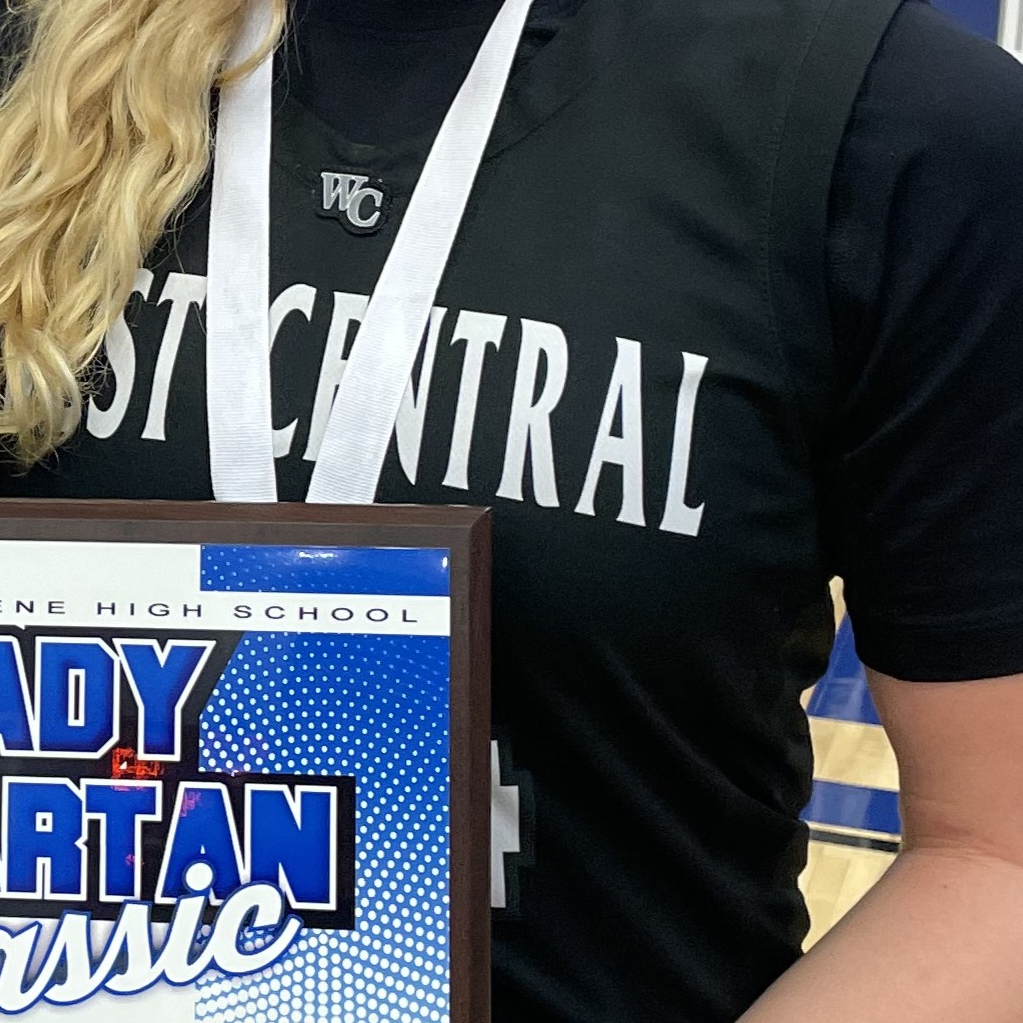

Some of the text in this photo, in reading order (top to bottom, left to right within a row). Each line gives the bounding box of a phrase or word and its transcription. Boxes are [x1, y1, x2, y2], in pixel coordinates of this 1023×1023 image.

[321, 172, 384, 227] WC
[86, 267, 208, 441] ST
[96, 602, 203, 619] HIGH
[233, 604, 418, 623] SCHOOL
